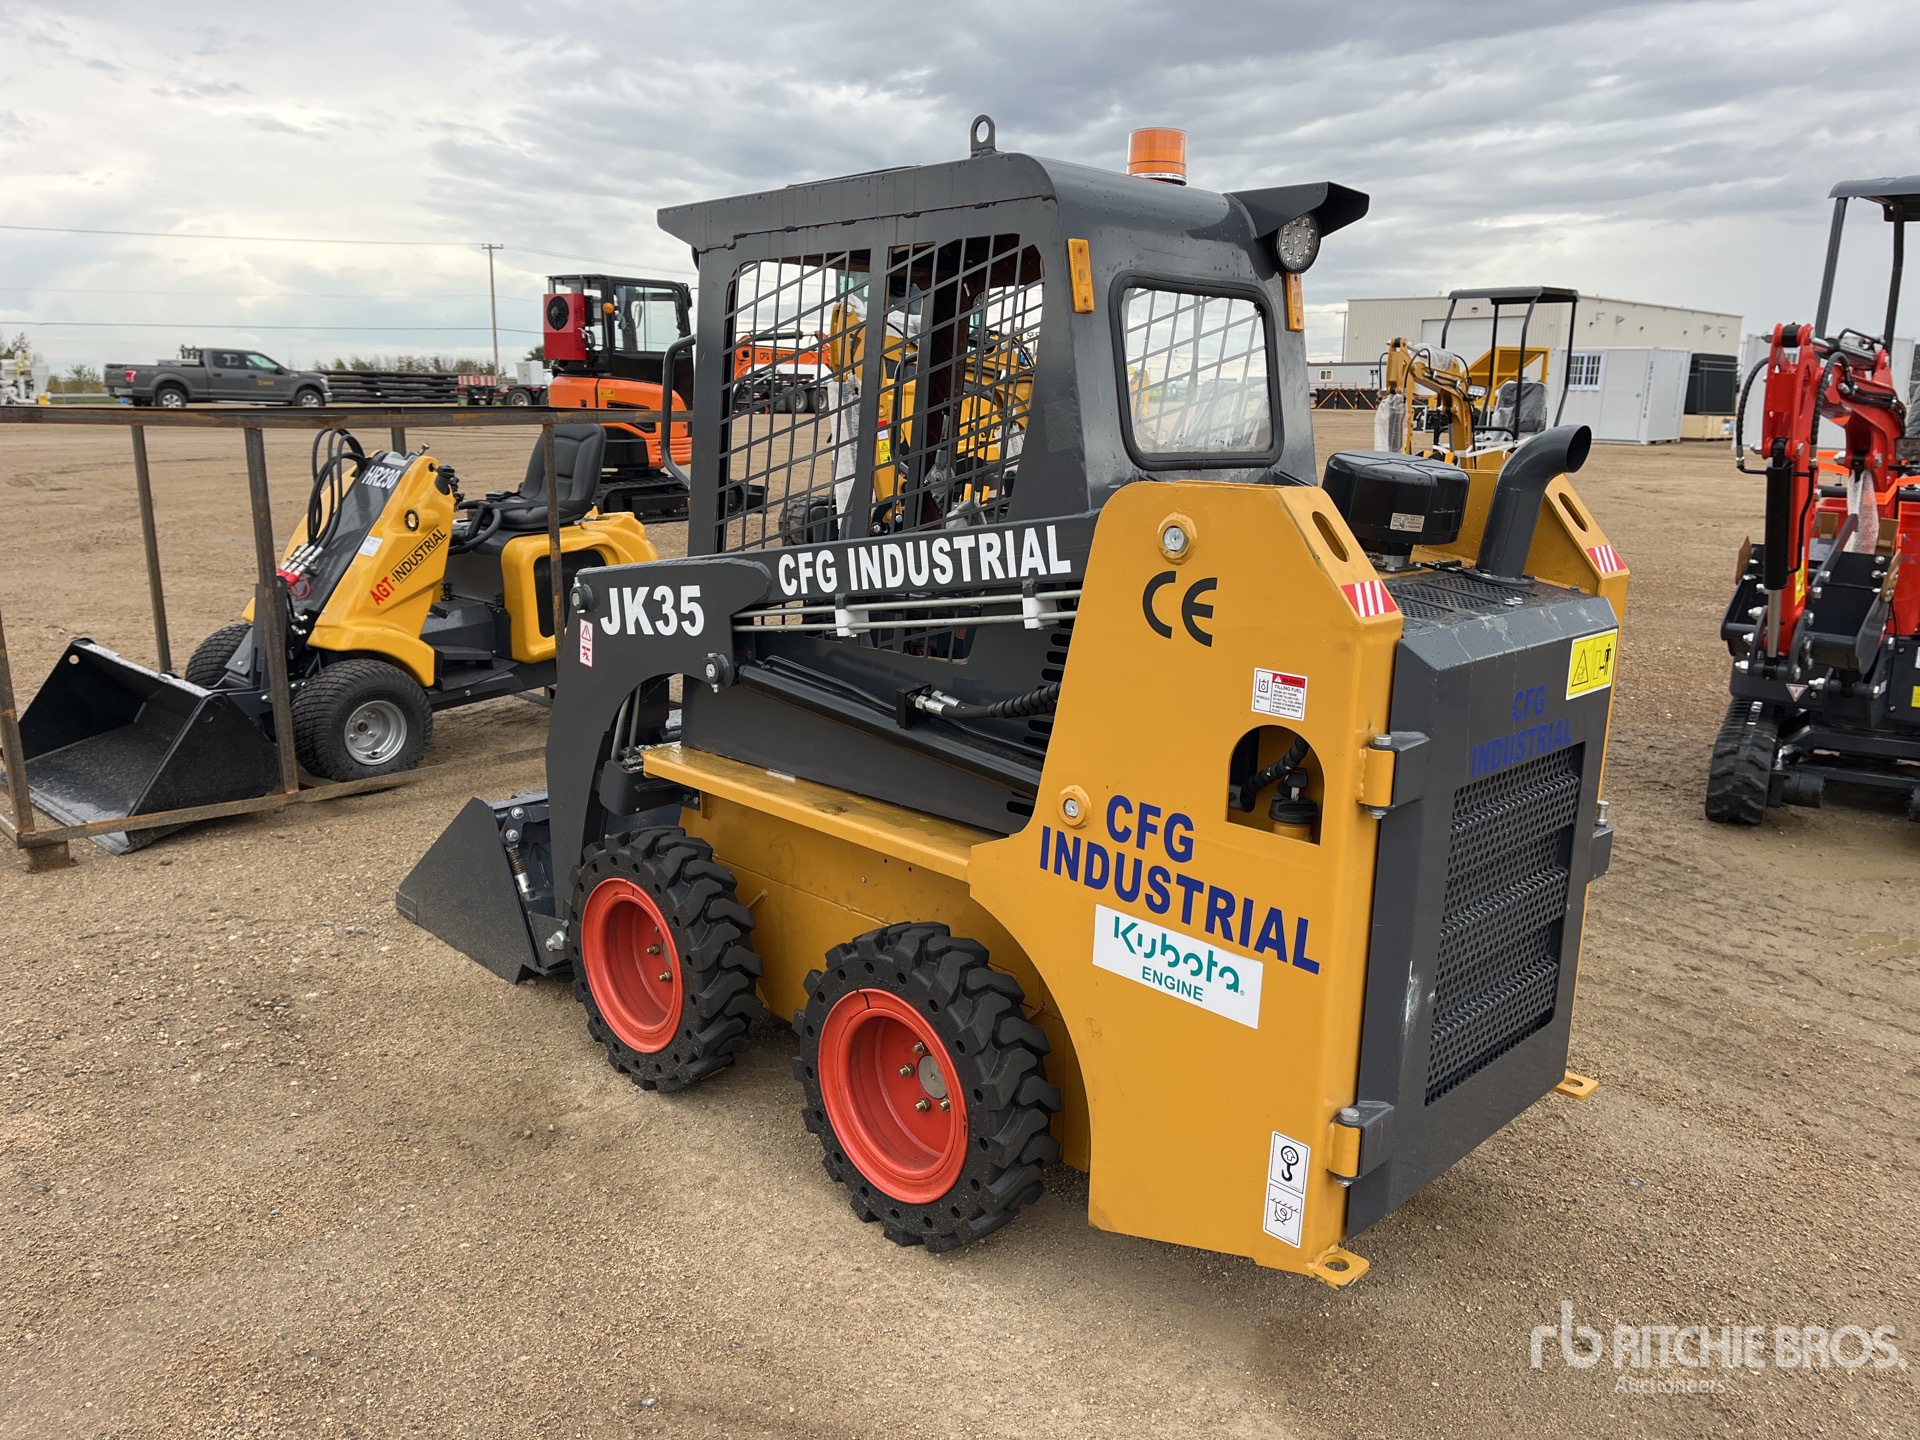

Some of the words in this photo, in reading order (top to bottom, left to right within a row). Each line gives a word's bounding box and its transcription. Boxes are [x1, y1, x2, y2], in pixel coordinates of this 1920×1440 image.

[361, 465, 402, 490] HR230
[779, 553, 838, 597] CFG
[848, 525, 1072, 590] INDUSTRIAL
[600, 585, 705, 637] JK35
[1512, 683, 1546, 723] CFG
[1470, 717, 1573, 779] INDUSTRIAL
[1106, 794, 1195, 864] CFG
[1039, 825, 1321, 975] INDUSTRIAL
[1113, 916, 1240, 994] Kubota
[1141, 966, 1204, 1002] ENGINE
